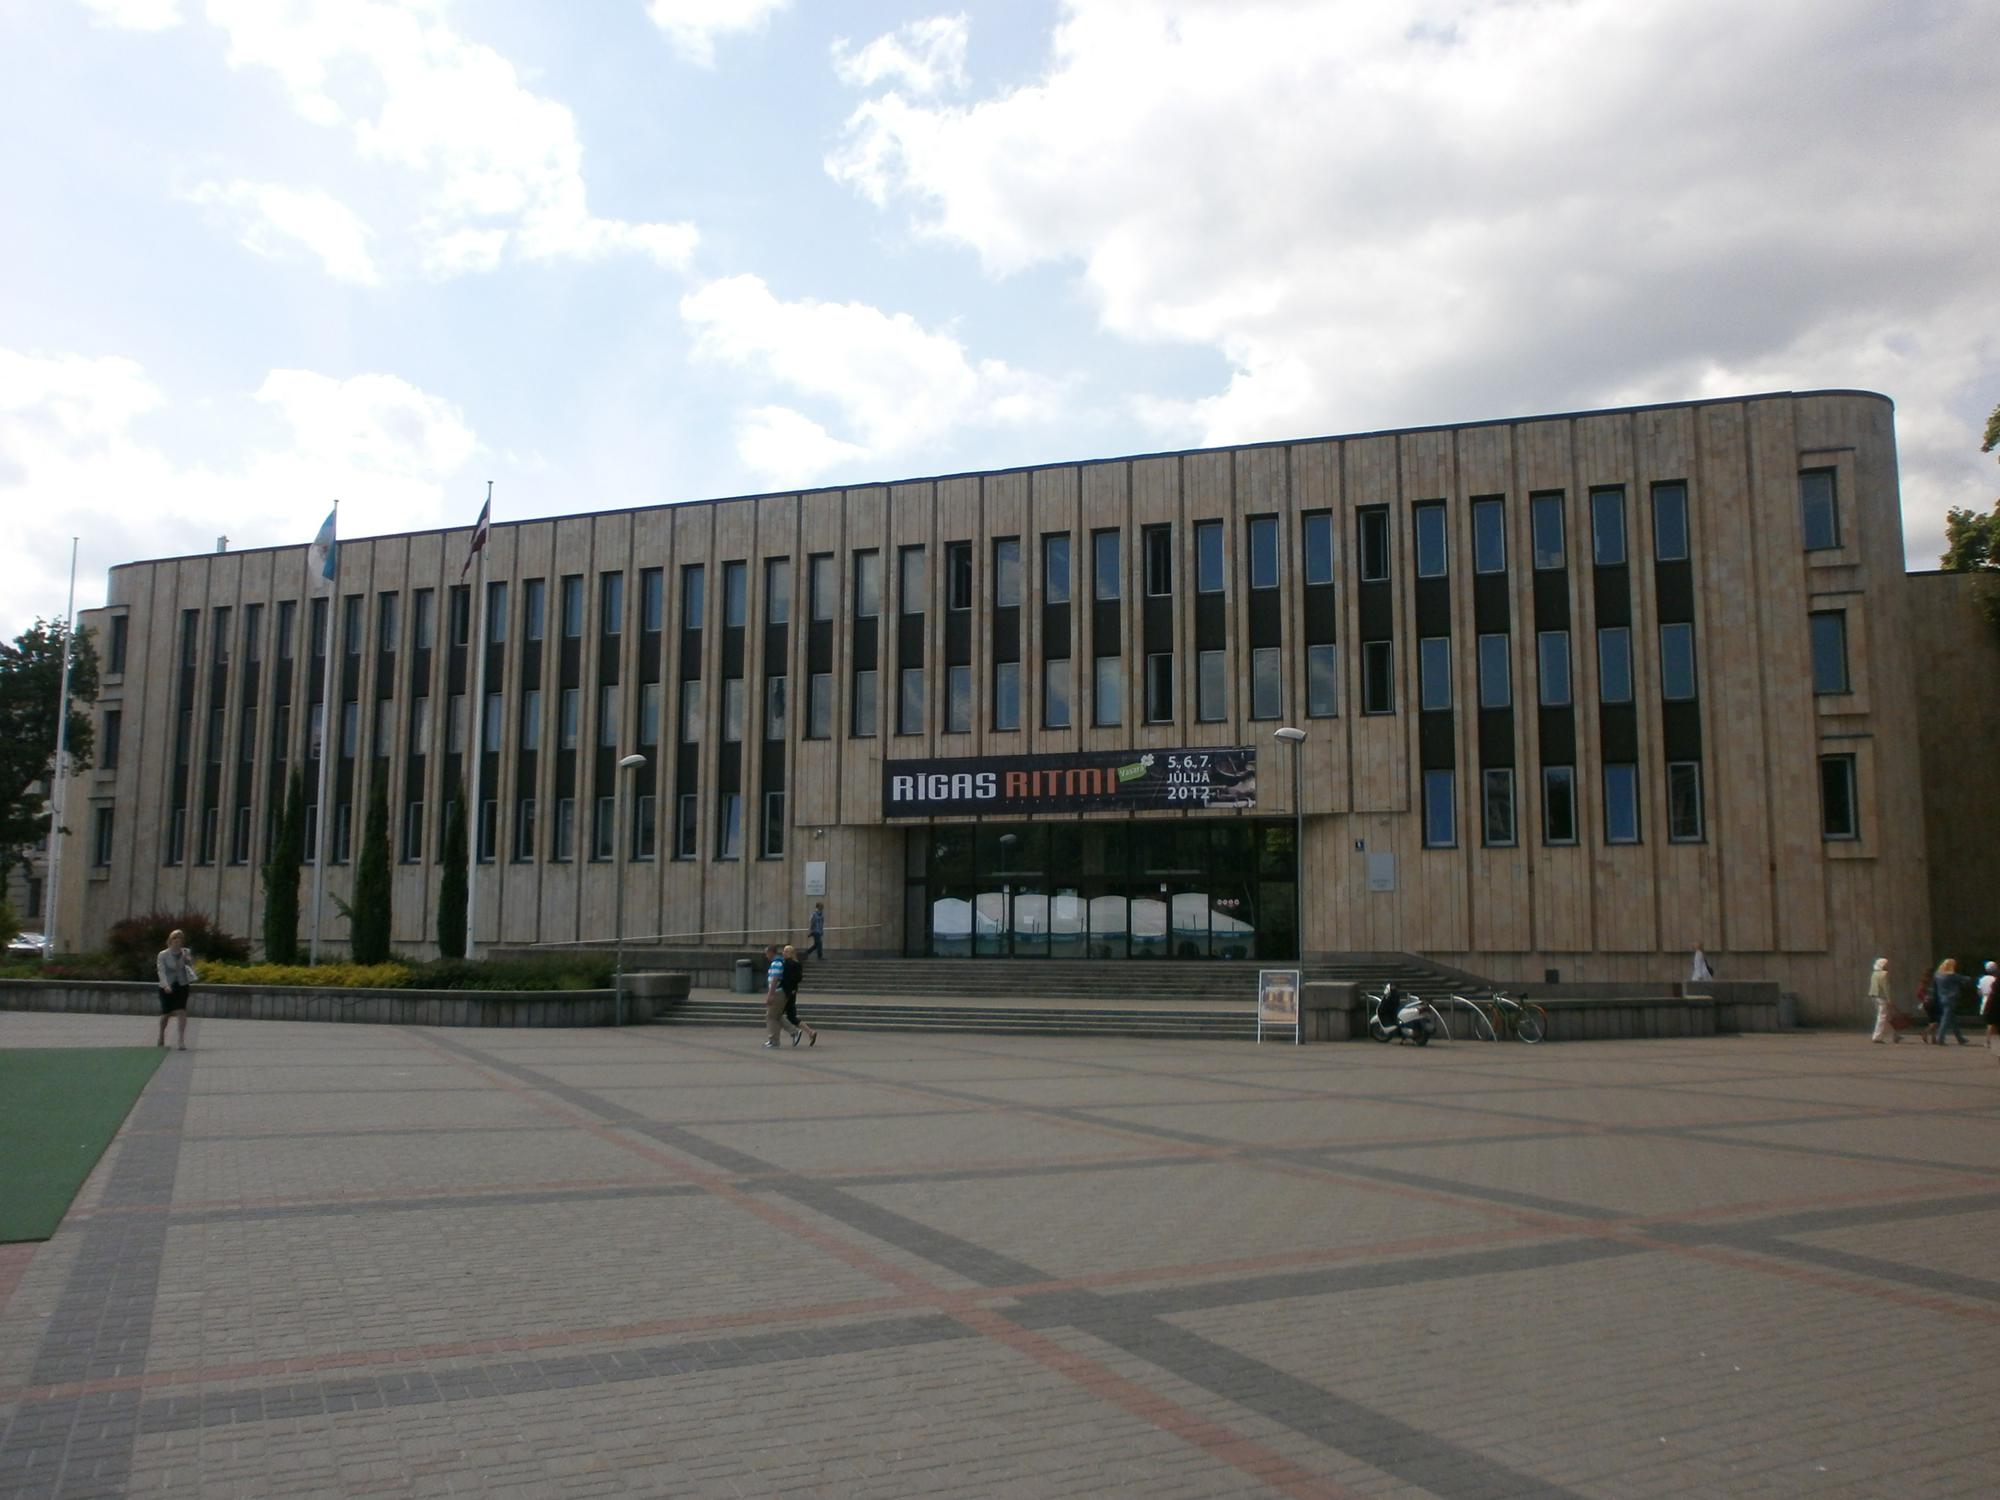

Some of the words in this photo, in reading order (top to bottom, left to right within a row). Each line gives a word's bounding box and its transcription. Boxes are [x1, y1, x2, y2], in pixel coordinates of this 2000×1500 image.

[893, 773, 997, 800] RĪGAS
[1006, 768, 1116, 798] RITMI
[1167, 770, 1210, 784] JŪLIJĀ
[1167, 787, 1210, 800] 2012
